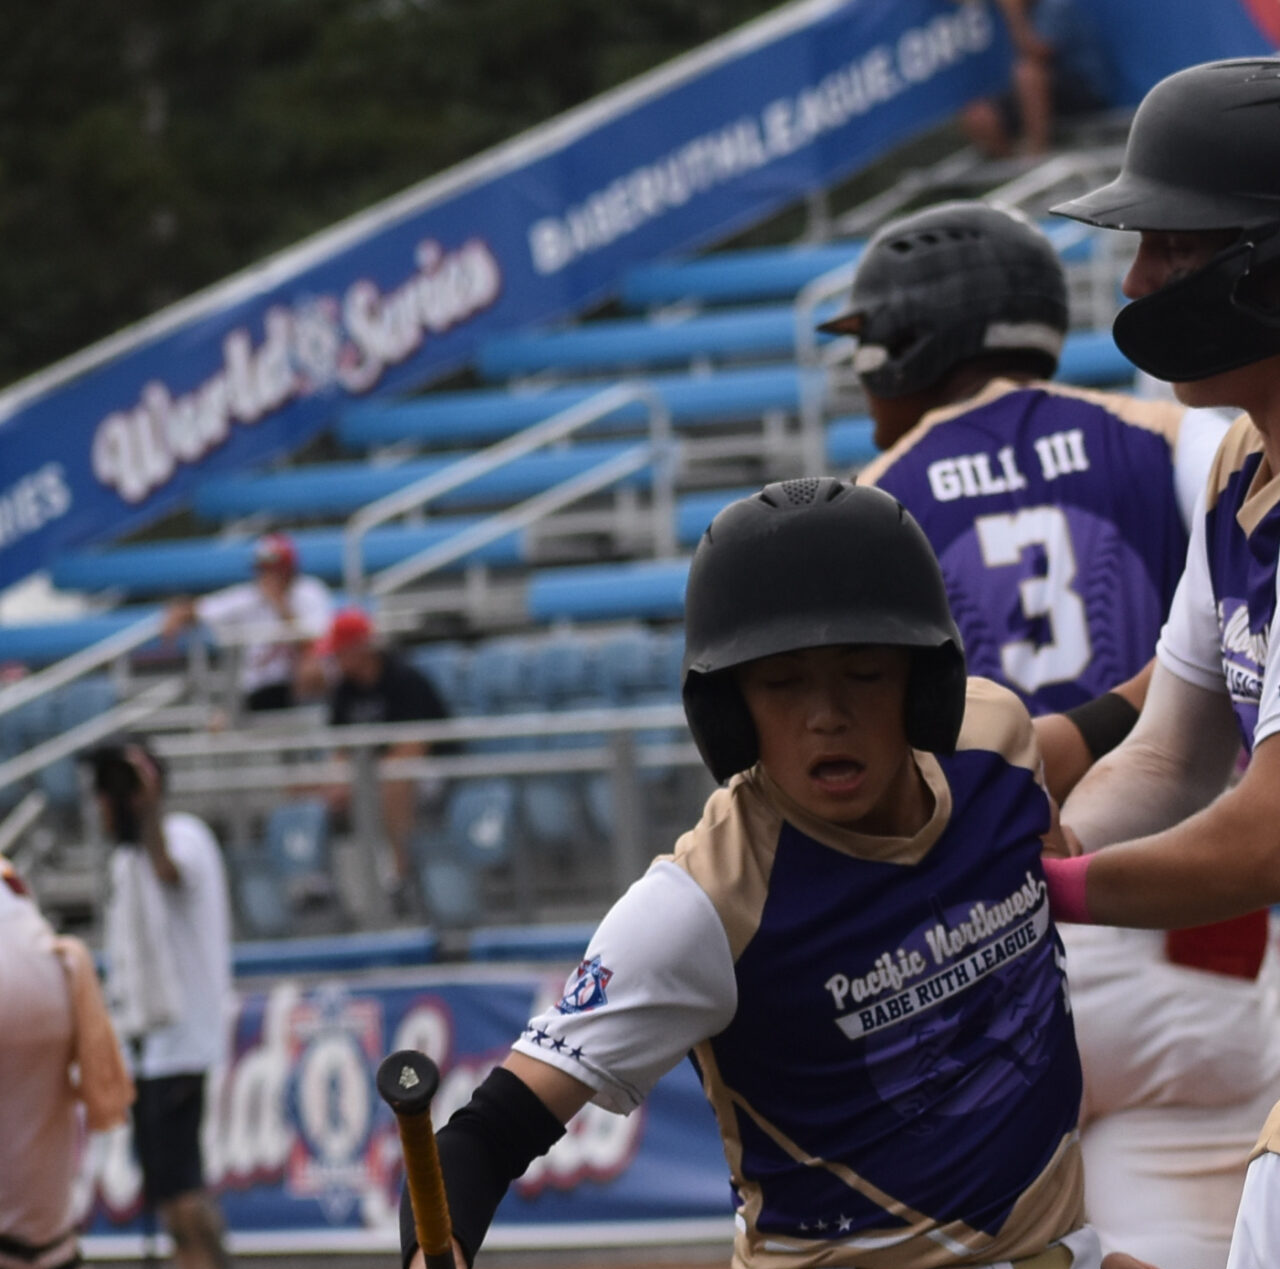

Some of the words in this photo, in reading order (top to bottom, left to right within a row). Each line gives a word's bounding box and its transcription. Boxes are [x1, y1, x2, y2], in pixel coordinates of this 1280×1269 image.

[91, 303, 301, 502] World
[336, 237, 502, 393] Series
[529, 2, 994, 276] BABERUTHLEAGUE.ORG
[927, 446, 1027, 502] GILL
[975, 504, 1092, 696] 3
[824, 948, 926, 1010] Pacific
[925, 871, 1047, 965] Northwest
[859, 993, 914, 1032] BABE
[916, 967, 970, 1007] RUTH
[970, 921, 1037, 978] LEAGUE
